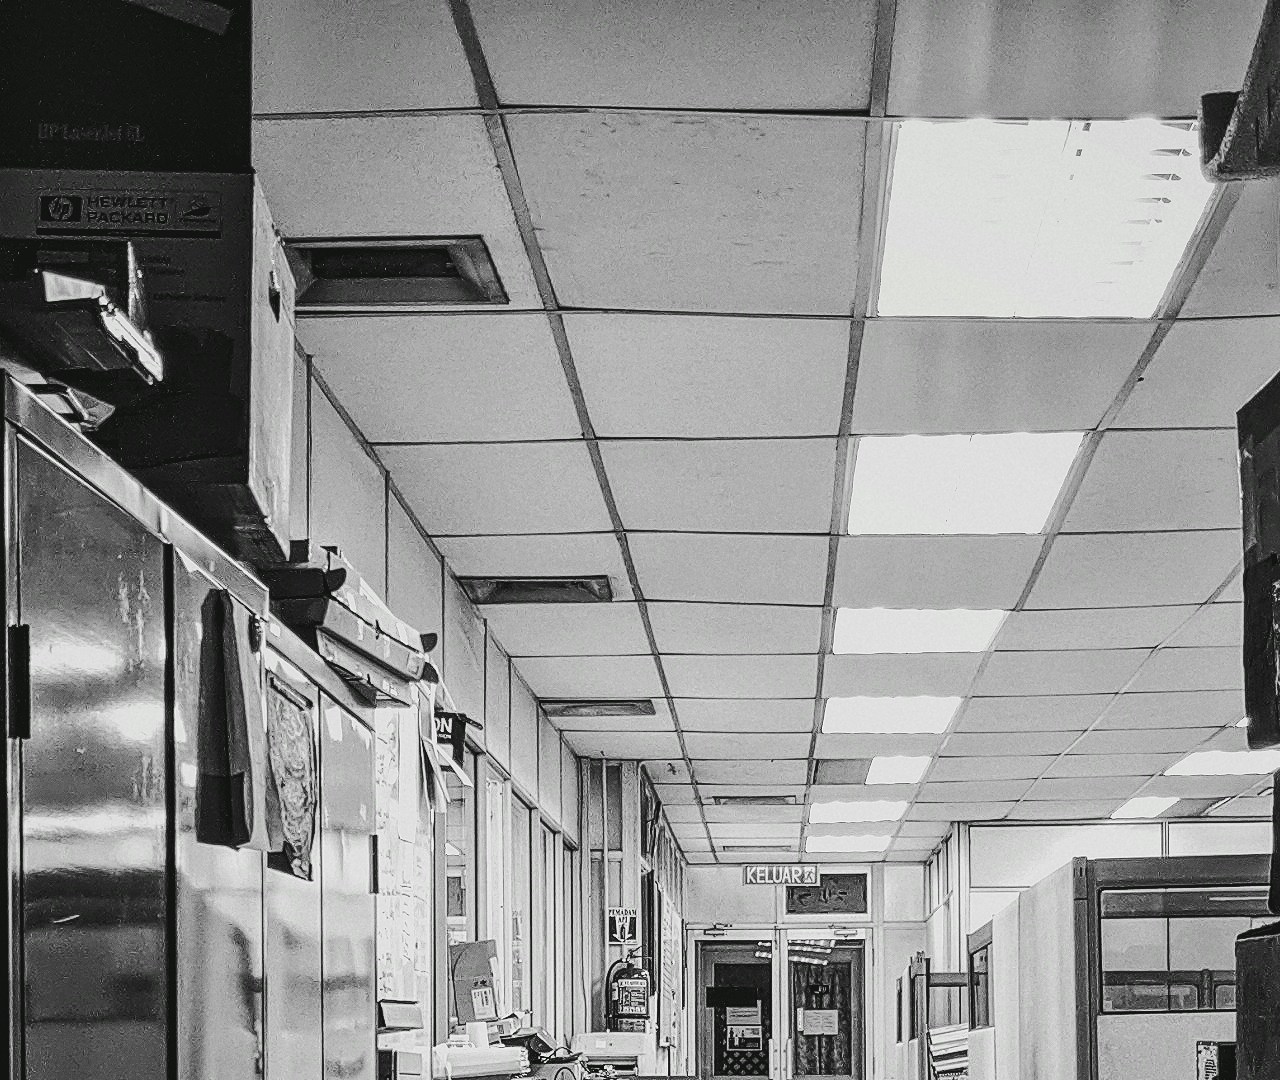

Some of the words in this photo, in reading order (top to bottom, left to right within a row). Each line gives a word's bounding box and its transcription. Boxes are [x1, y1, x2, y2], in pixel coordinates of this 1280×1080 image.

[87, 196, 168, 208] HEWLETT
[87, 211, 168, 224] PACKARD
[746, 866, 801, 884] KELUAR
